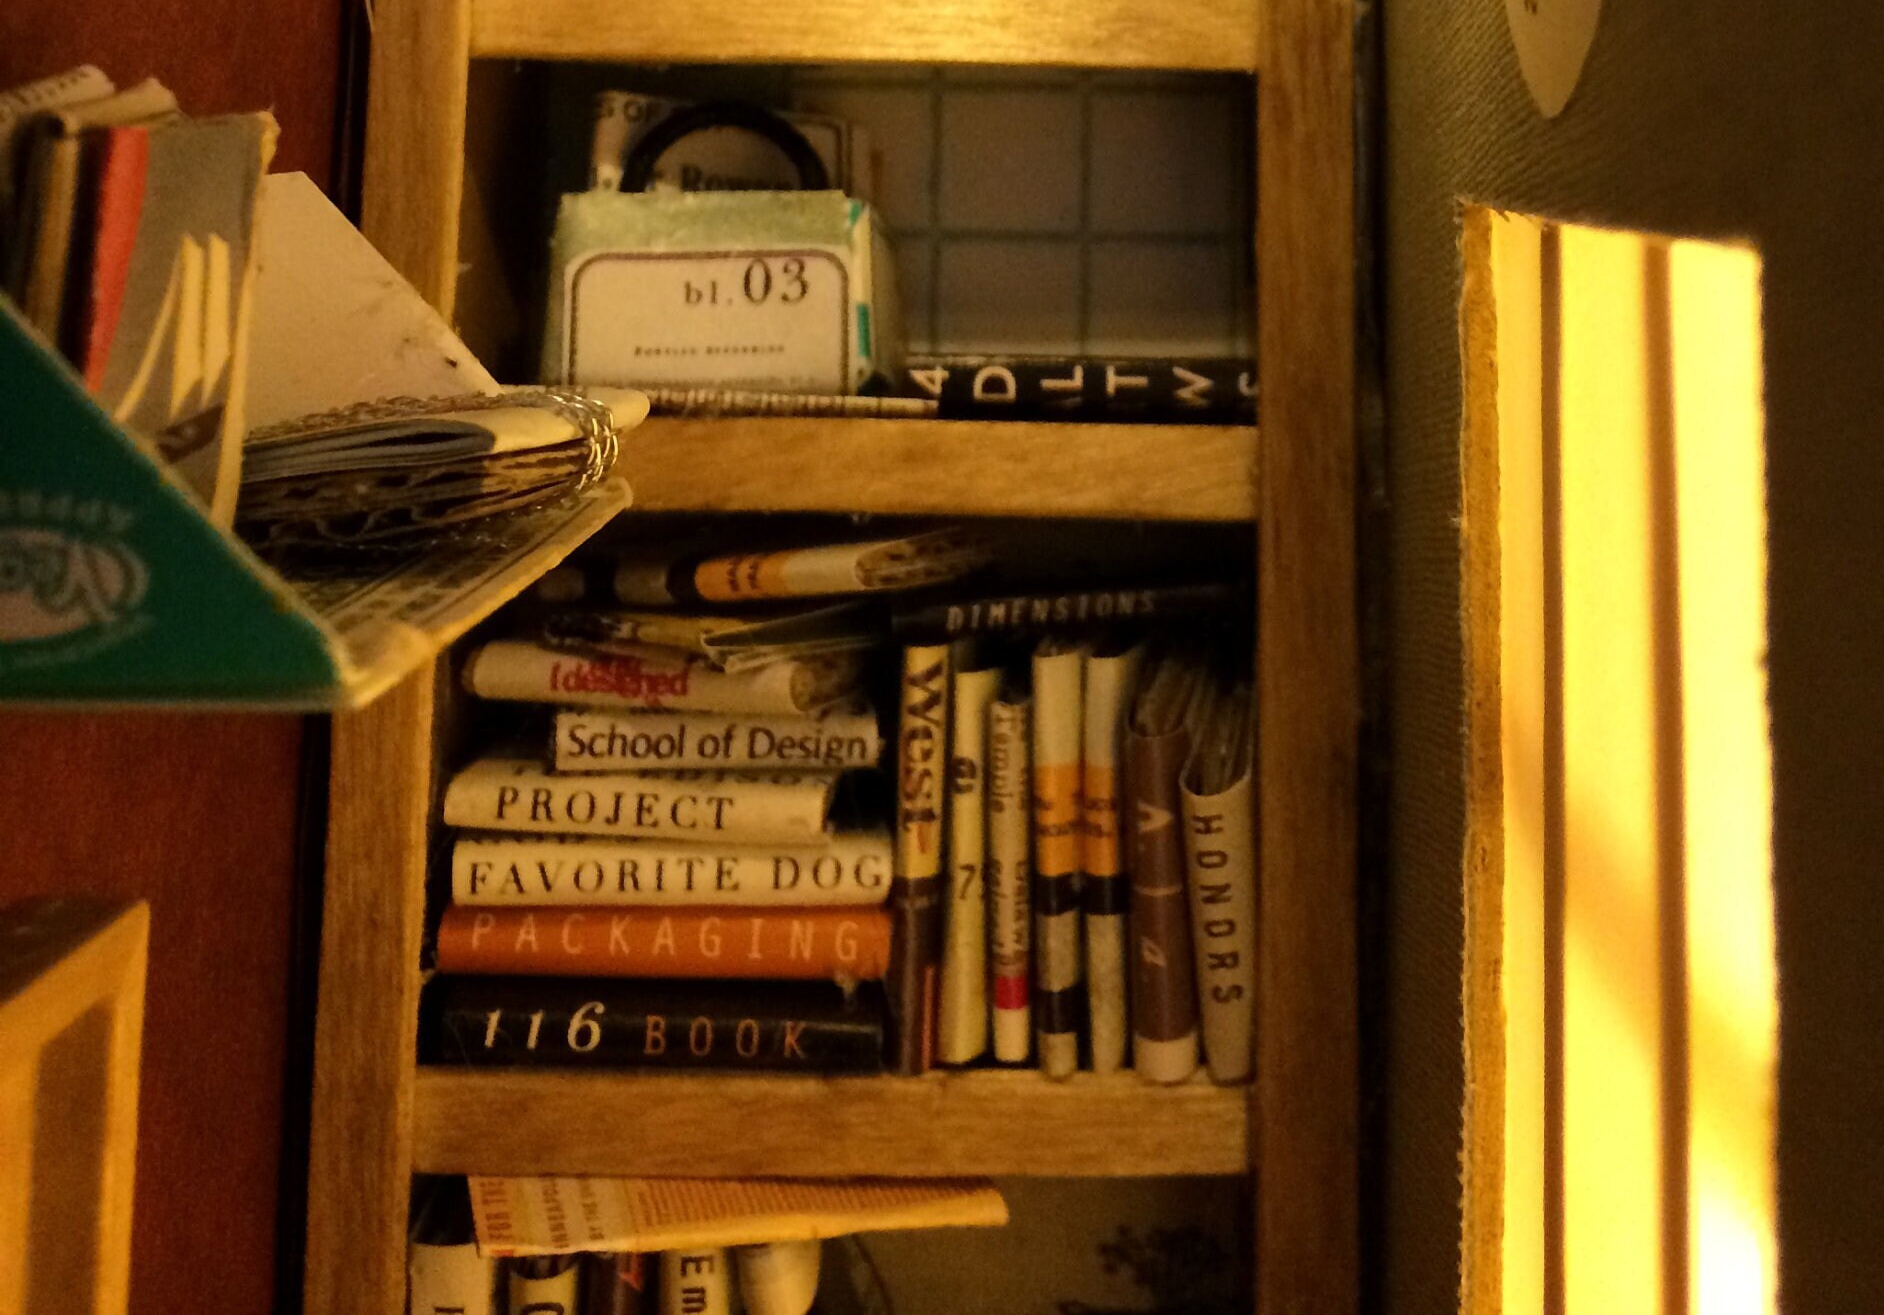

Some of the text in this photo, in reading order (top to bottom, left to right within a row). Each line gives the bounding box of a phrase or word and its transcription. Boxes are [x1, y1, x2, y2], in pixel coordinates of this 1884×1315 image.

[946, 590, 1154, 631] DIMENSIONS
[568, 723, 868, 766] School of Design
[496, 786, 734, 831] PROJECT
[469, 854, 884, 896] FAVORITE DOG
[1190, 813, 1244, 1004] HONORS
[470, 912, 861, 962] PACKAGING
[483, 1000, 808, 1059] 116 BOOK
